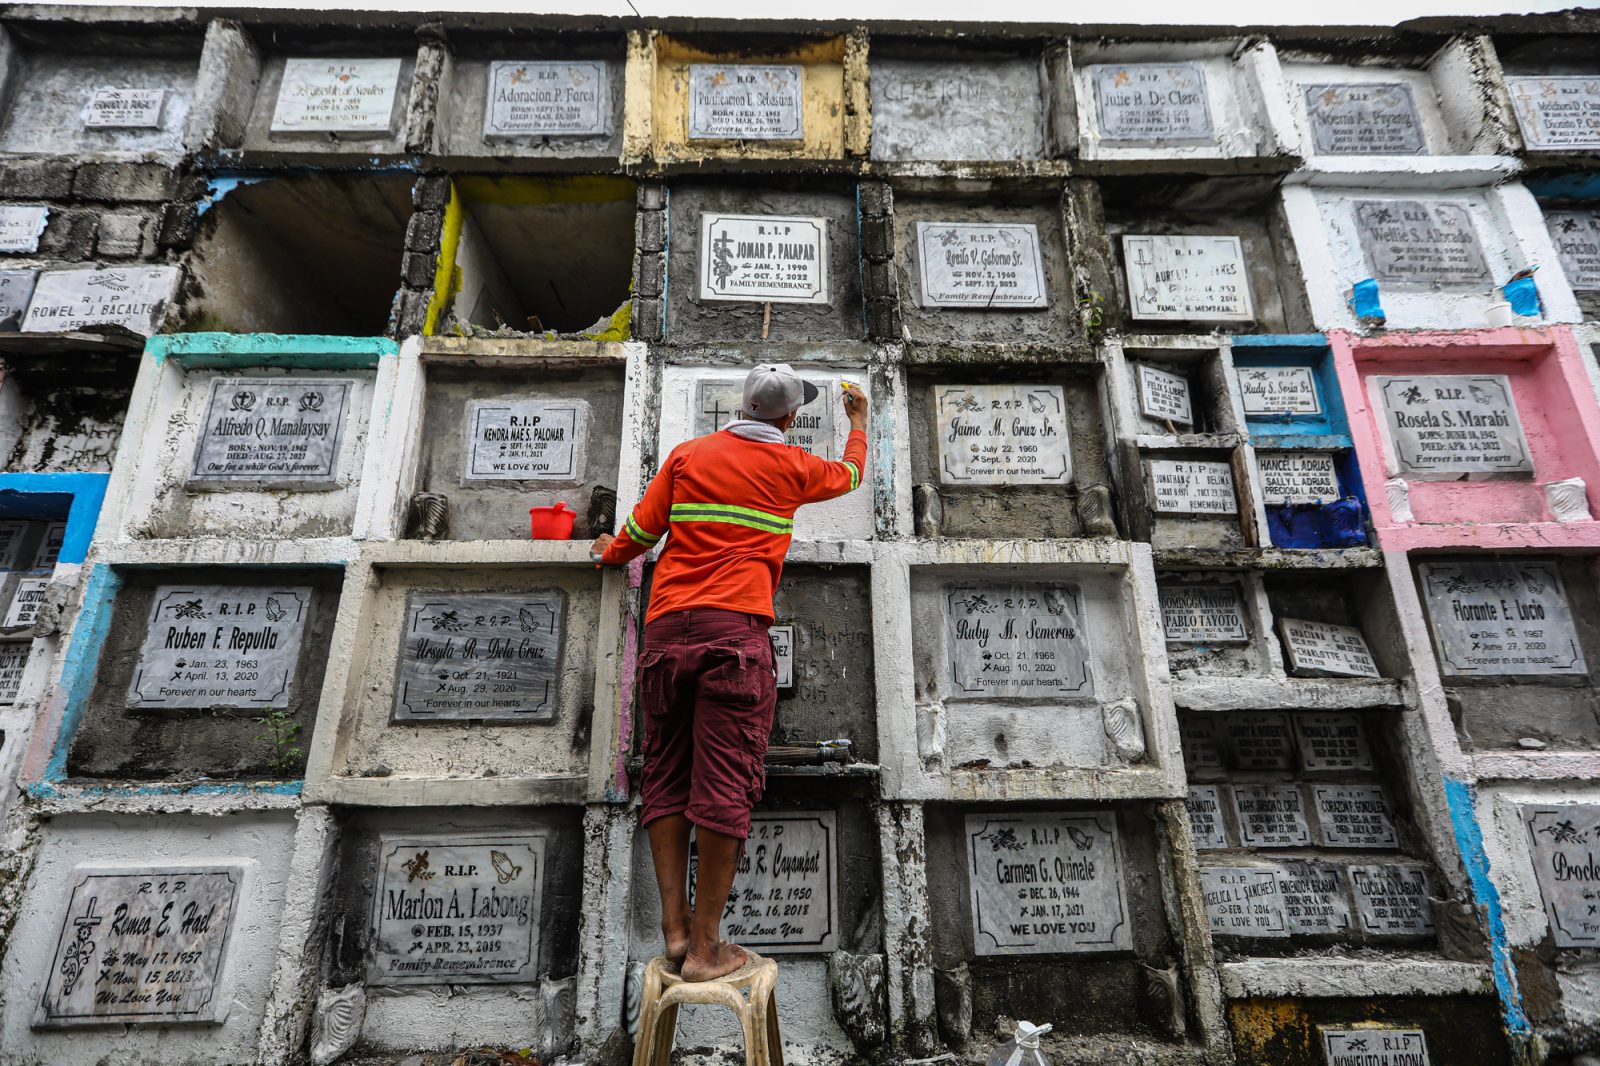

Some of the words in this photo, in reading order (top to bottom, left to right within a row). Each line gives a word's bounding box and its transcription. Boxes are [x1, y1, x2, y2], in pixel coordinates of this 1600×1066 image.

[498, 88, 551, 102] Adoracion
[736, 241, 765, 259] JOMAR
[778, 243, 815, 260] PALAPAR
[757, 281, 812, 290] REMEMBRANCE
[939, 293, 969, 301] Family
[32, 306, 75, 317] ROWEL
[1244, 383, 1266, 398] Rudy
[1394, 411, 1440, 428] Rosela
[1456, 410, 1510, 428] Marabi
[213, 418, 253, 436] Alfredo
[270, 418, 331, 441] Manalaysay
[484, 428, 509, 441] KENDRA
[533, 428, 565, 441] PALOMAR
[949, 417, 982, 443] Jaime
[1012, 417, 1036, 436] Cruz
[1039, 417, 1056, 436] Sr.
[228, 444, 252, 452] BORN
[982, 446, 998, 454] July
[1415, 454, 1451, 463] Forever
[245, 463, 267, 471] while
[1301, 460, 1331, 471] ADRIAS
[1452, 600, 1497, 621] Florante
[1500, 600, 1513, 620] E.
[1515, 599, 1545, 620] Lucio
[1165, 616, 1197, 627] PABLO
[1199, 616, 1238, 626] TAYOTO
[956, 619, 989, 648] Ruby
[1026, 618, 1076, 640] Semeros
[165, 626, 207, 649] Ruben
[213, 627, 224, 649] F.
[228, 627, 278, 655] Repulla
[416, 639, 454, 659] Ursula
[488, 638, 513, 659] Dela
[518, 638, 546, 659] Cruz
[1297, 647, 1341, 661] CHARLOTTE
[189, 660, 208, 668] Jan.
[235, 660, 258, 668] 1963
[993, 664, 1012, 673] Aug.
[1035, 663, 1056, 671] 2020
[234, 672, 258, 681] 2020
[496, 672, 518, 680] 1921
[159, 687, 196, 696] Forever
[227, 687, 257, 697] hearts
[447, 685, 468, 695] Aug.
[494, 685, 516, 693] 2020
[444, 865, 478, 876] R.I.P.
[996, 858, 1037, 884] Carmen
[1039, 857, 1053, 882] G.
[1054, 856, 1096, 885] Quinale
[743, 888, 764, 902] Nov.
[788, 888, 812, 900] 1950
[1029, 888, 1046, 899] DEC.
[386, 889, 443, 920] Marlon
[446, 888, 464, 919] A.
[470, 886, 529, 926] Labong
[742, 905, 762, 917] Dec.
[784, 904, 809, 915] 2018
[1030, 906, 1049, 917] JAN.
[1066, 904, 1084, 916] 2021
[108, 903, 151, 938] Romeo
[1212, 917, 1225, 927] WE
[1232, 917, 1250, 926] LOVE
[1255, 916, 1271, 926] YOU
[426, 926, 454, 938] FEB.
[477, 924, 503, 937] 1937
[727, 924, 749, 936] We
[750, 924, 777, 936] Love
[780, 923, 804, 938] You
[1010, 924, 1030, 936] WE
[1033, 923, 1067, 934] LOVE
[1068, 922, 1096, 933] YOU
[424, 942, 453, 954] APR.
[457, 942, 473, 953] 23,
[476, 941, 502, 952] 2019
[123, 952, 149, 968] May
[173, 951, 202, 965] 1957
[388, 959, 430, 972] Family
[113, 971, 136, 985] Nov.
[96, 992, 118, 1005] We
[119, 990, 152, 1004] Love
[156, 989, 182, 1006] You
